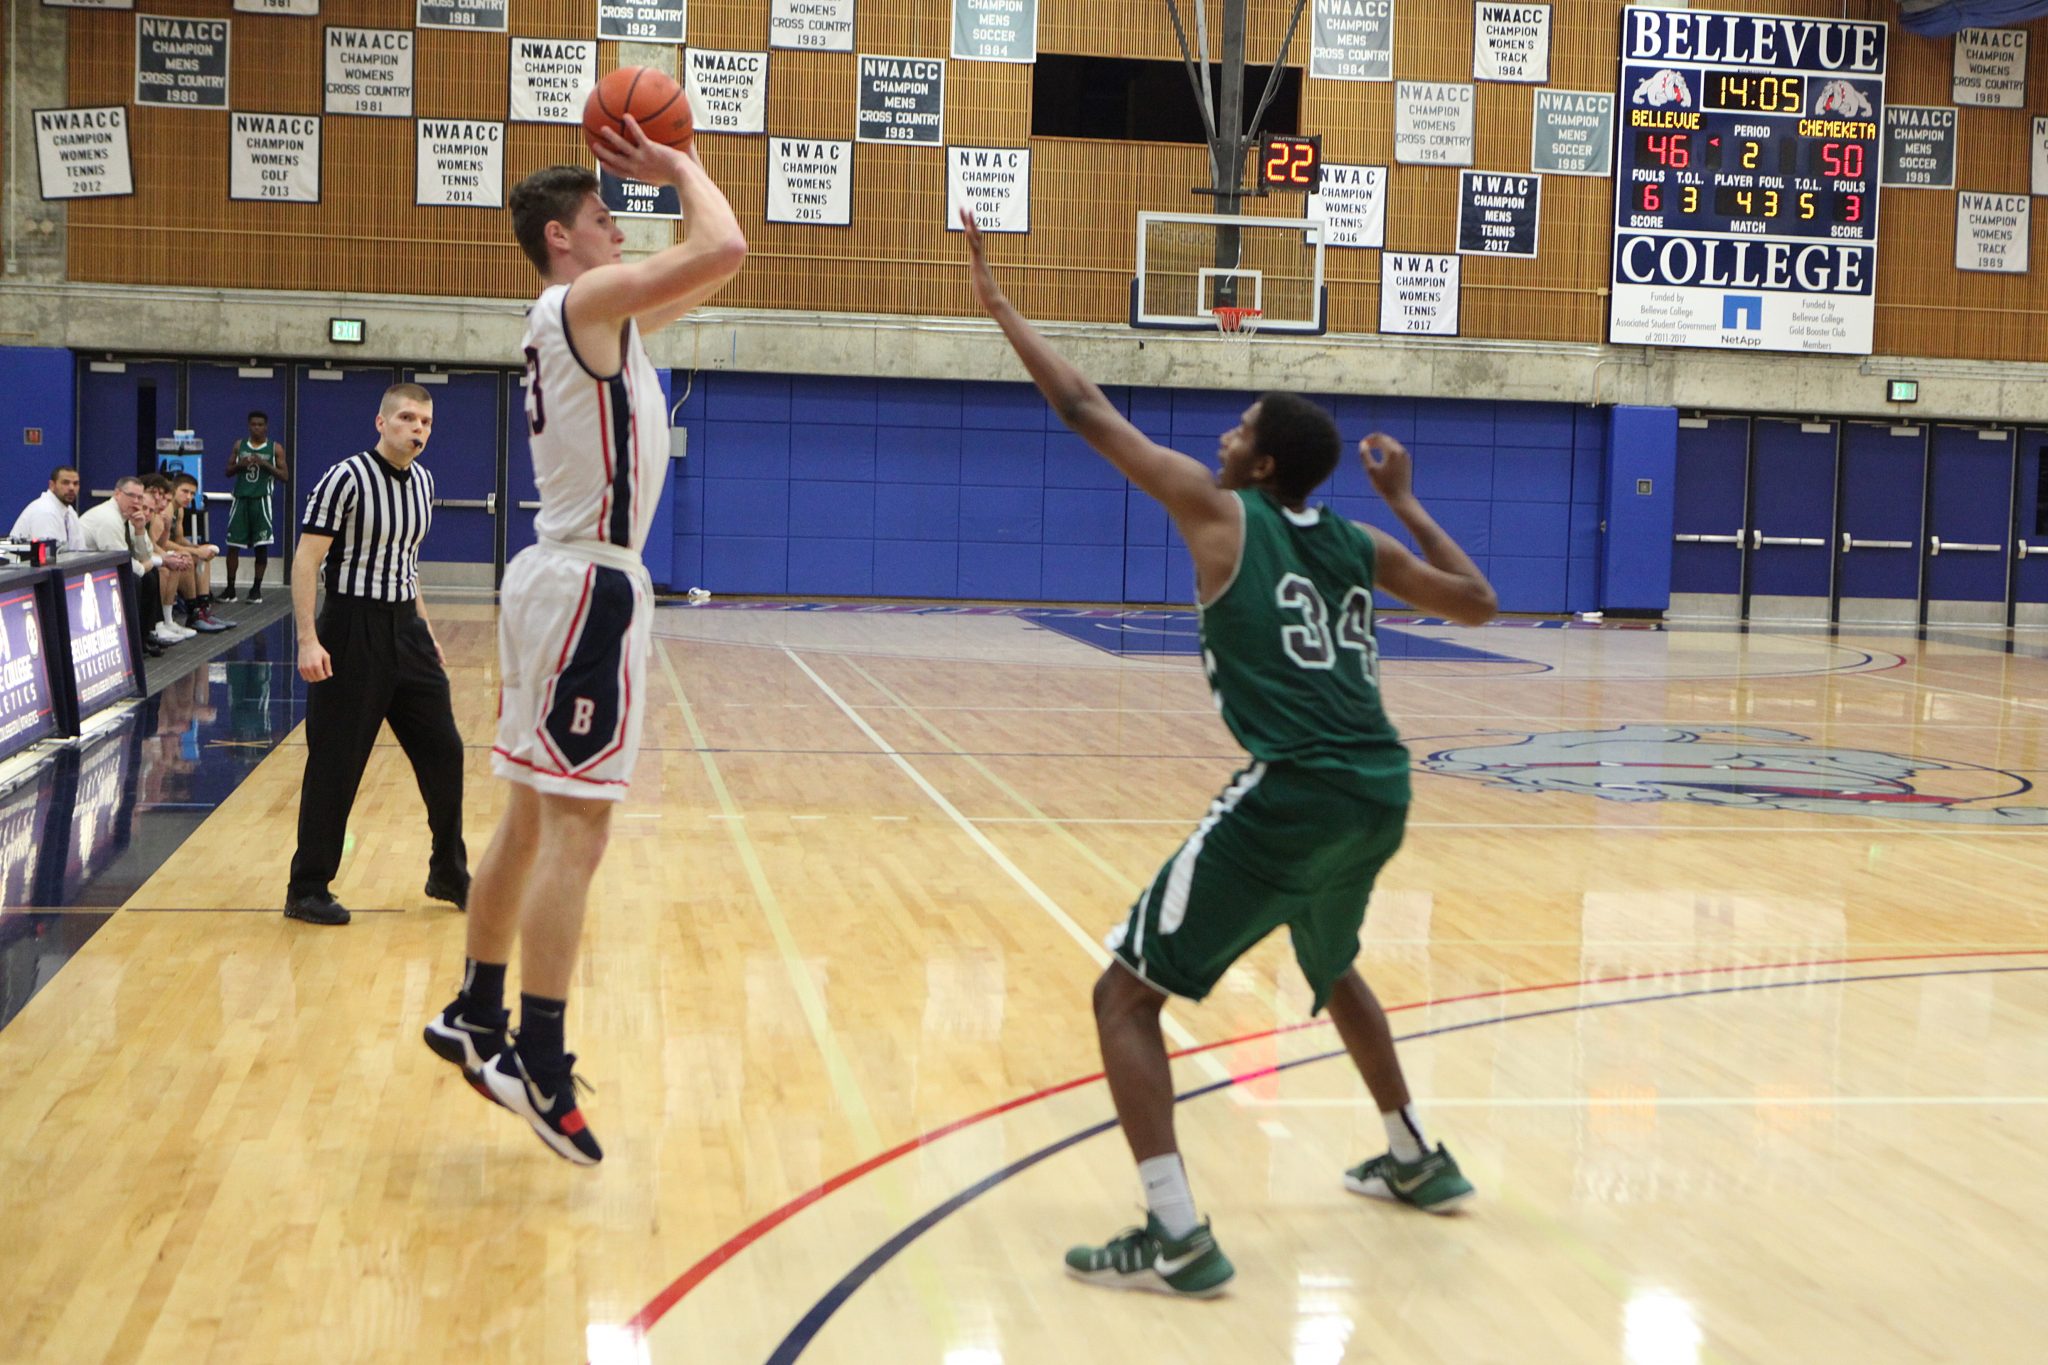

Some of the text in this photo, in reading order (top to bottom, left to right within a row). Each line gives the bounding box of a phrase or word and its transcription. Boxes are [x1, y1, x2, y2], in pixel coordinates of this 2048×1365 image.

[790, 4, 836, 16] WOMENS
[968, 0, 1023, 11] CHAMPION
[1318, 0, 1388, 17] NWAACC
[449, 12, 476, 25] 1981
[601, 6, 682, 22] CROSS COUNTRY
[979, 15, 1010, 26] MENS
[1482, 7, 1543, 24] NWAACC
[142, 19, 224, 40] NWAACC
[627, 23, 656, 36] 1982
[773, 17, 851, 32] CROSS COUNTRY
[1326, 18, 1379, 32] CHAMPION
[1486, 25, 1538, 37] CHAMPION
[330, 32, 409, 50] NWAACC
[797, 34, 826, 46] 1983
[973, 30, 1015, 42] SOCCER
[1337, 34, 1366, 46] MENS
[1632, 11, 1878, 71] BELLEVUE
[152, 41, 213, 56] CHAMPION
[521, 44, 586, 60] NWAACC
[979, 44, 1008, 57] 1984
[1314, 48, 1390, 61] CROSS COUNTRY
[340, 53, 398, 66] CHAMPION
[1494, 52, 1528, 63] TRACK
[1966, 49, 2014, 62] CHAMPION
[165, 58, 199, 71] MENS
[525, 63, 582, 74] CHAMPION
[694, 54, 759, 72] NWAACC
[1337, 63, 1365, 75] 1984
[345, 69, 394, 80] WOMENS
[864, 60, 938, 80] NWAACC
[1498, 65, 1523, 76] 1984
[1969, 64, 2009, 76] WOMENS
[139, 73, 225, 88] CROSS COUNTRY
[697, 73, 753, 85] CHAMPION
[1954, 77, 2024, 90] CROSS COUNTRY
[326, 83, 410, 97] CROSS COUNTRY
[873, 81, 928, 94] CHAMPION
[1400, 84, 1470, 102] NWAACC
[1720, 76, 1800, 112] 14:05
[167, 90, 197, 102] 1980
[536, 91, 571, 102] TRACK
[356, 100, 382, 112] 1981
[707, 101, 742, 111] TRACK
[885, 97, 916, 109] MENS
[1539, 93, 1609, 113] NWAACC
[538, 107, 568, 117] 1982
[1409, 105, 1460, 117] CHAMPION
[40, 111, 120, 131] NWAACC
[710, 115, 738, 126] 1983
[861, 110, 939, 126] CROSS COUNTRY
[1547, 114, 1599, 127] CHAMPION
[1888, 109, 1952, 127] NWAACC
[237, 116, 314, 135] NWAACC
[1412, 119, 1455, 131] WOMENS
[1631, 110, 1876, 140] BELLEVUE CHEMEKETA
[1734, 125, 1770, 138] PERIOD
[423, 123, 498, 141] NWAACC
[885, 127, 913, 139] 1983
[1558, 129, 1587, 141] MENS
[1895, 129, 1944, 141] CHAMPION
[53, 133, 112, 146] CHAMPION
[246, 138, 304, 151] CHAMPION
[1396, 133, 1471, 146] CROSS COUNTRY
[59, 149, 108, 161] WOMENS
[432, 144, 488, 156] CHAMPION
[1420, 149, 1446, 159] 1984
[1552, 144, 1593, 156] SOCCER
[1648, 135, 1689, 168] 46
[1742, 142, 1758, 168] 2
[1905, 144, 1931, 155] MENS
[251, 153, 299, 166] WOMENS
[437, 159, 483, 171] WOMENS
[1267, 142, 1313, 183] 22
[1557, 159, 1585, 170] 1985
[1822, 143, 1863, 177] 50
[1899, 158, 1936, 169] SOCCER
[66, 165, 105, 177] TENNIS
[783, 162, 837, 175] CHAMPION
[261, 170, 288, 181] GOLF
[442, 175, 478, 186] TENNIS
[962, 171, 1015, 183] CHAMPION
[1632, 169, 1665, 182] FOULS
[1715, 174, 1784, 189] PLAYER FOUL
[1906, 172, 1930, 183] 1989
[788, 177, 832, 189] WOMENS
[1834, 180, 1865, 193] FOULS
[446, 190, 472, 202] 2014
[622, 184, 660, 197] TENNIS
[966, 186, 1010, 198] WOMENS
[1322, 188, 1372, 200] CHAMPION
[791, 193, 827, 205] TENNIS
[1474, 195, 1525, 209] CHAMPION
[1643, 184, 1659, 211] 6
[1683, 186, 1697, 212] 3
[1736, 191, 1752, 213] 4
[1764, 191, 1778, 217] 3
[1962, 195, 2025, 213] NWAACC
[627, 200, 654, 212] 2015
[976, 202, 1000, 212] GOLF
[1325, 202, 1367, 214] WOMENS
[1800, 193, 1814, 219] 5
[1846, 195, 1859, 221] 3
[795, 208, 822, 219] 2015
[1485, 210, 1512, 223] MENS
[1329, 217, 1363, 228] TENNIS
[1631, 215, 1663, 228] SCORE
[1731, 220, 1766, 233] MATCH
[1969, 215, 2017, 226] CHAMPION
[1333, 232, 1357, 242] 2016
[1481, 225, 1515, 238] TENNIS
[1831, 226, 1863, 238] SCORE
[1972, 229, 2012, 240] WOMENS
[1484, 239, 1509, 252] 2017
[1978, 243, 2006, 254] TRACK
[1621, 236, 1863, 292] COLLEGE
[1395, 276, 1446, 288] CHAMPION
[1399, 290, 1441, 302] WOMENS
[1651, 292, 1684, 304] Funded by
[1403, 305, 1436, 316] TENNIS
[1640, 304, 1693, 317] Bellevue College
[1802, 299, 1835, 310] Funded by
[1407, 319, 1431, 330] 2017
[1616, 318, 1717, 331] Associated Student Government
[1792, 312, 1844, 325] Bellevue College
[1789, 326, 1846, 337] Gold Booster Club
[1721, 335, 1761, 346] NetApp
[1802, 340, 1832, 350] Members
[246, 463, 260, 483] 3
[1275, 572, 1379, 687] 34
[570, 697, 595, 735] B
